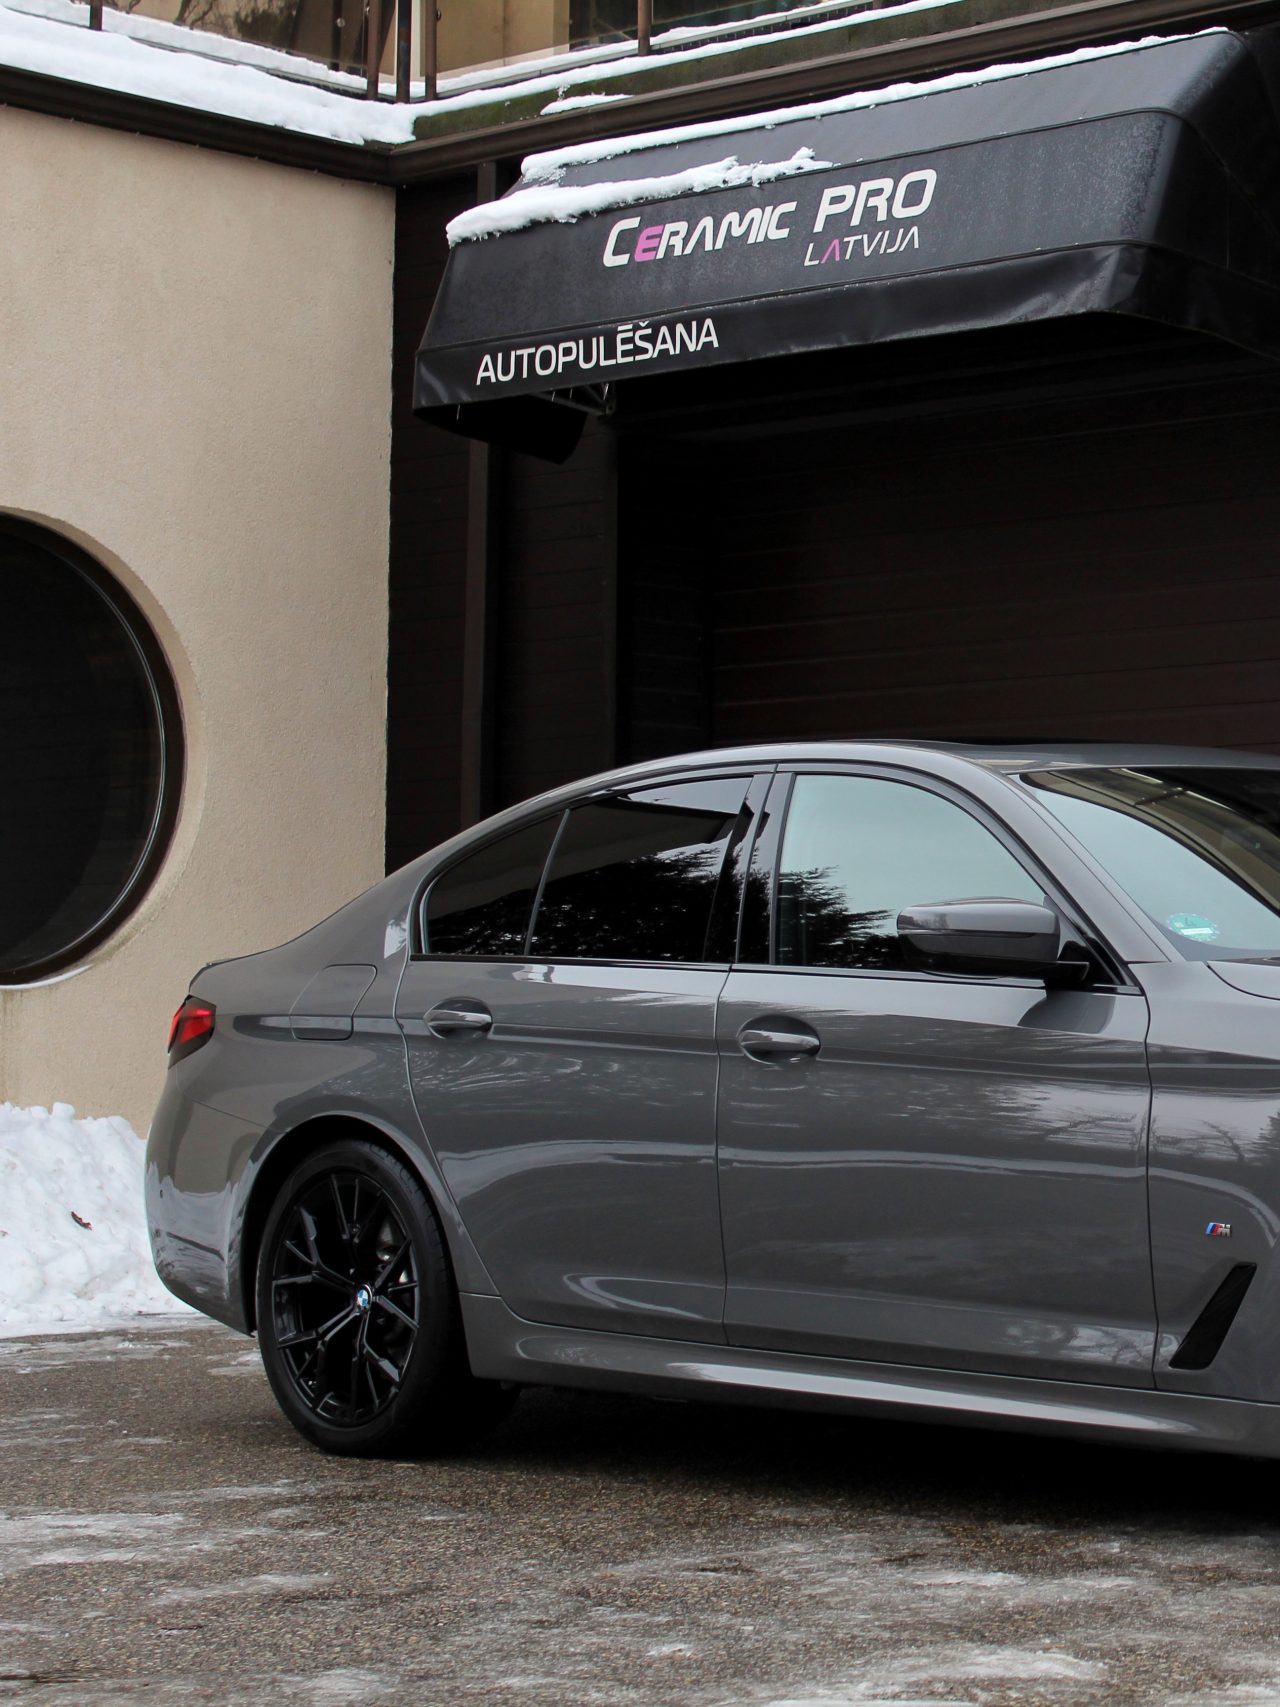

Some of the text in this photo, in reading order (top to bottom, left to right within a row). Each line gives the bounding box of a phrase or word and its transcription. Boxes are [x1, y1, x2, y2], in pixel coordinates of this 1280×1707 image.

[602, 168, 938, 268] CERAMIC PRO
[803, 225, 920, 267] LATVIJA
[476, 318, 720, 386] AUTOPULĒŠANA
